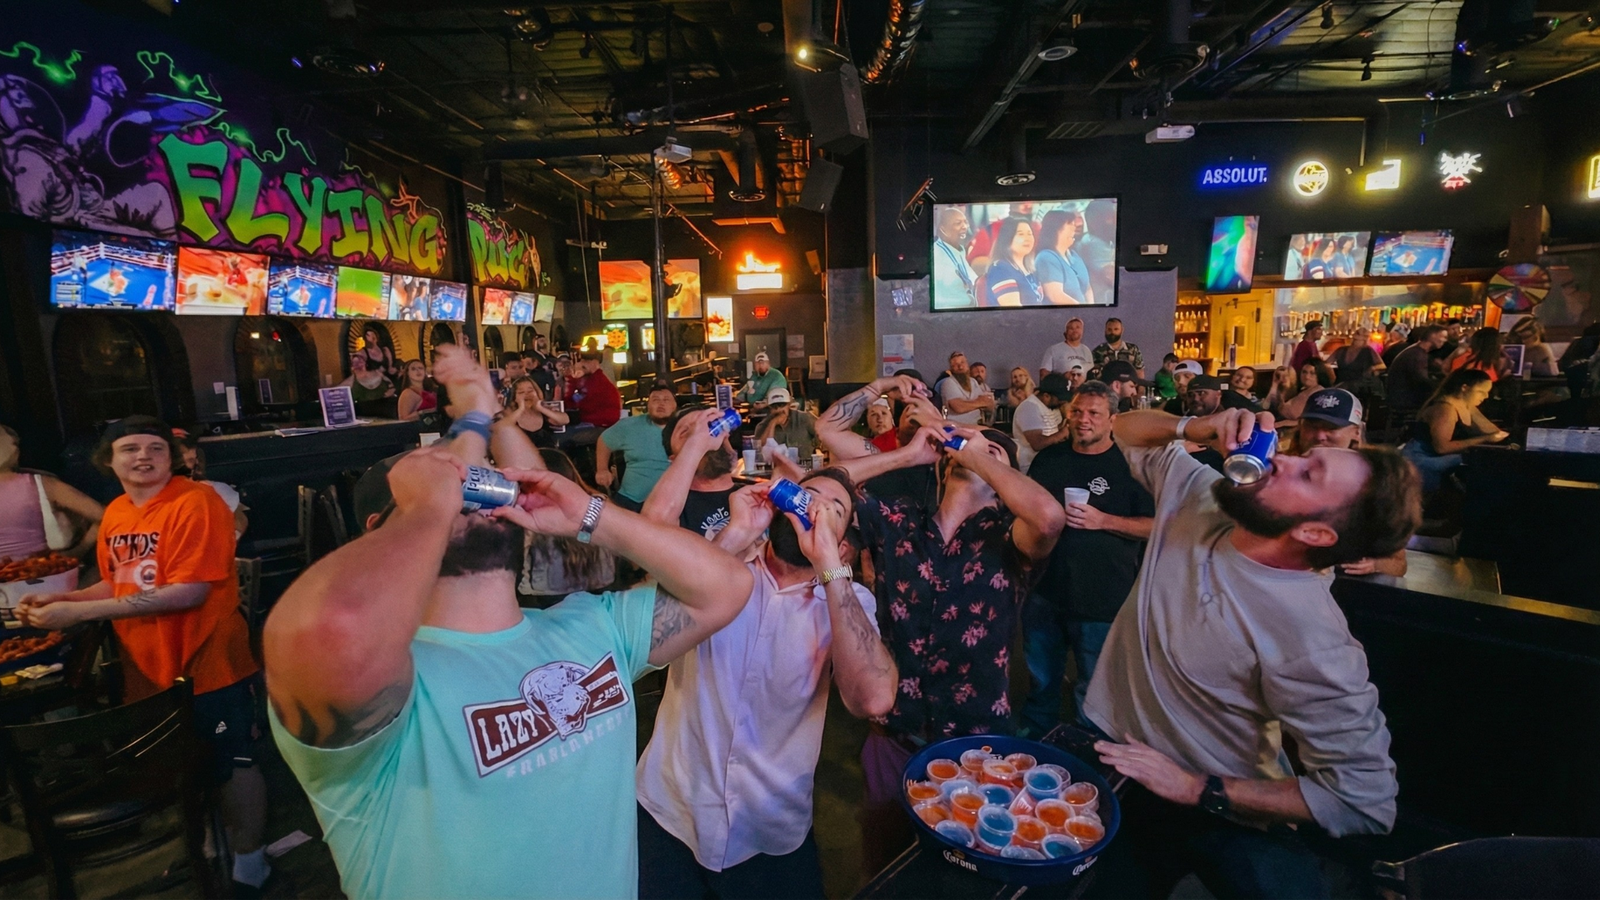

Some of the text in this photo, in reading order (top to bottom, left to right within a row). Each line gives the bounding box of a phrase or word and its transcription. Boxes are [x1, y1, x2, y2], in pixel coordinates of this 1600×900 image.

[158, 133, 438, 274] FLYING
[477, 709, 540, 761] LAZY
[942, 849, 979, 873] Corona
